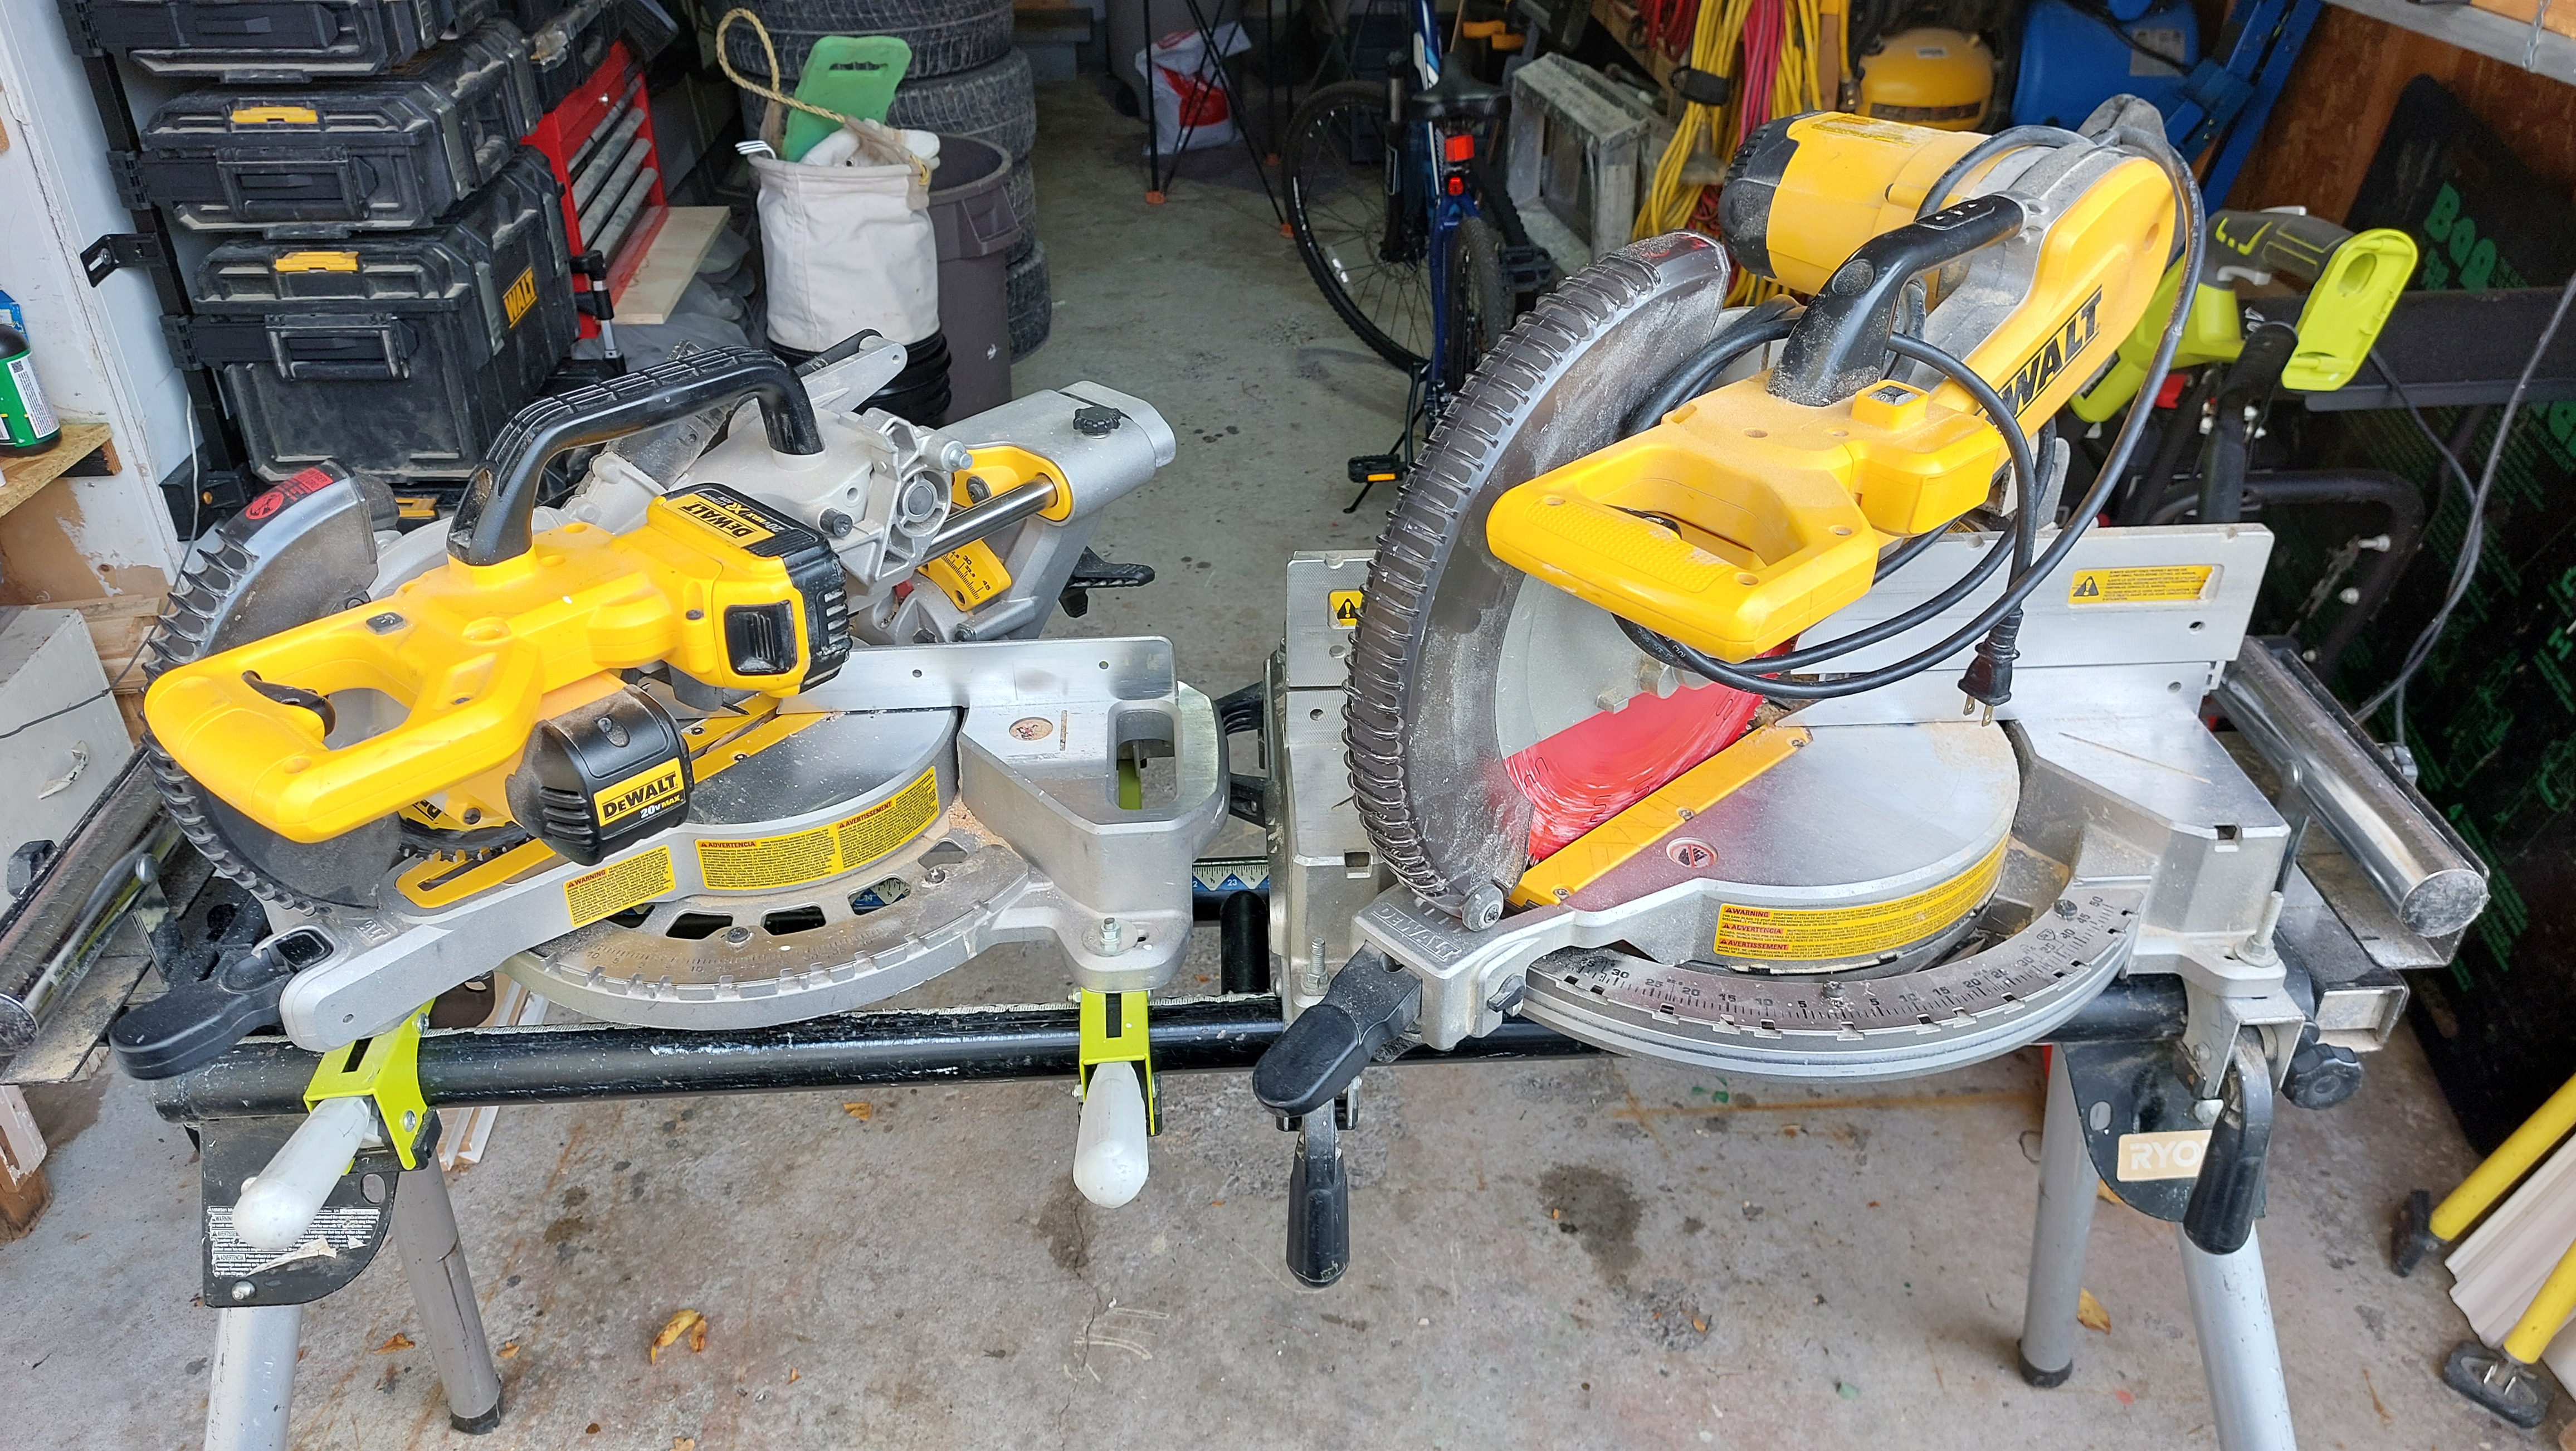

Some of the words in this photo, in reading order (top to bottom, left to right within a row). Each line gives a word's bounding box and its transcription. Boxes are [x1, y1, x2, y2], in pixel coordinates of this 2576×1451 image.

[1999, 289, 2102, 419] WALT
[680, 501, 757, 538] DEWALT
[982, 580, 991, 591] 45
[602, 773, 677, 819] DEWALT
[661, 794, 681, 808] MAX
[845, 801, 892, 827] AVERTISSEMENT
[574, 869, 607, 885] WARNING
[2089, 896, 2103, 908] 50
[1733, 908, 1769, 917] WARNING
[2077, 912, 2091, 924] 45
[1731, 925, 1782, 934] ADVERTENCIA
[2061, 928, 2076, 939] 40
[1728, 940, 1787, 950] AVERTISSEMENT
[2017, 956, 2034, 967] 30
[1611, 968, 1630, 979] 30
[1645, 978, 1664, 988] 25
[1963, 977, 1982, 989] 20
[1681, 986, 1701, 997] 20
[1932, 986, 1951, 996] 15
[1718, 993, 1736, 1002] 15
[1868, 998, 1880, 1006] 5
[1899, 992, 1918, 1003] 10
[1797, 1000, 1808, 1009] 5
[2129, 1139, 2206, 1170] RYO
